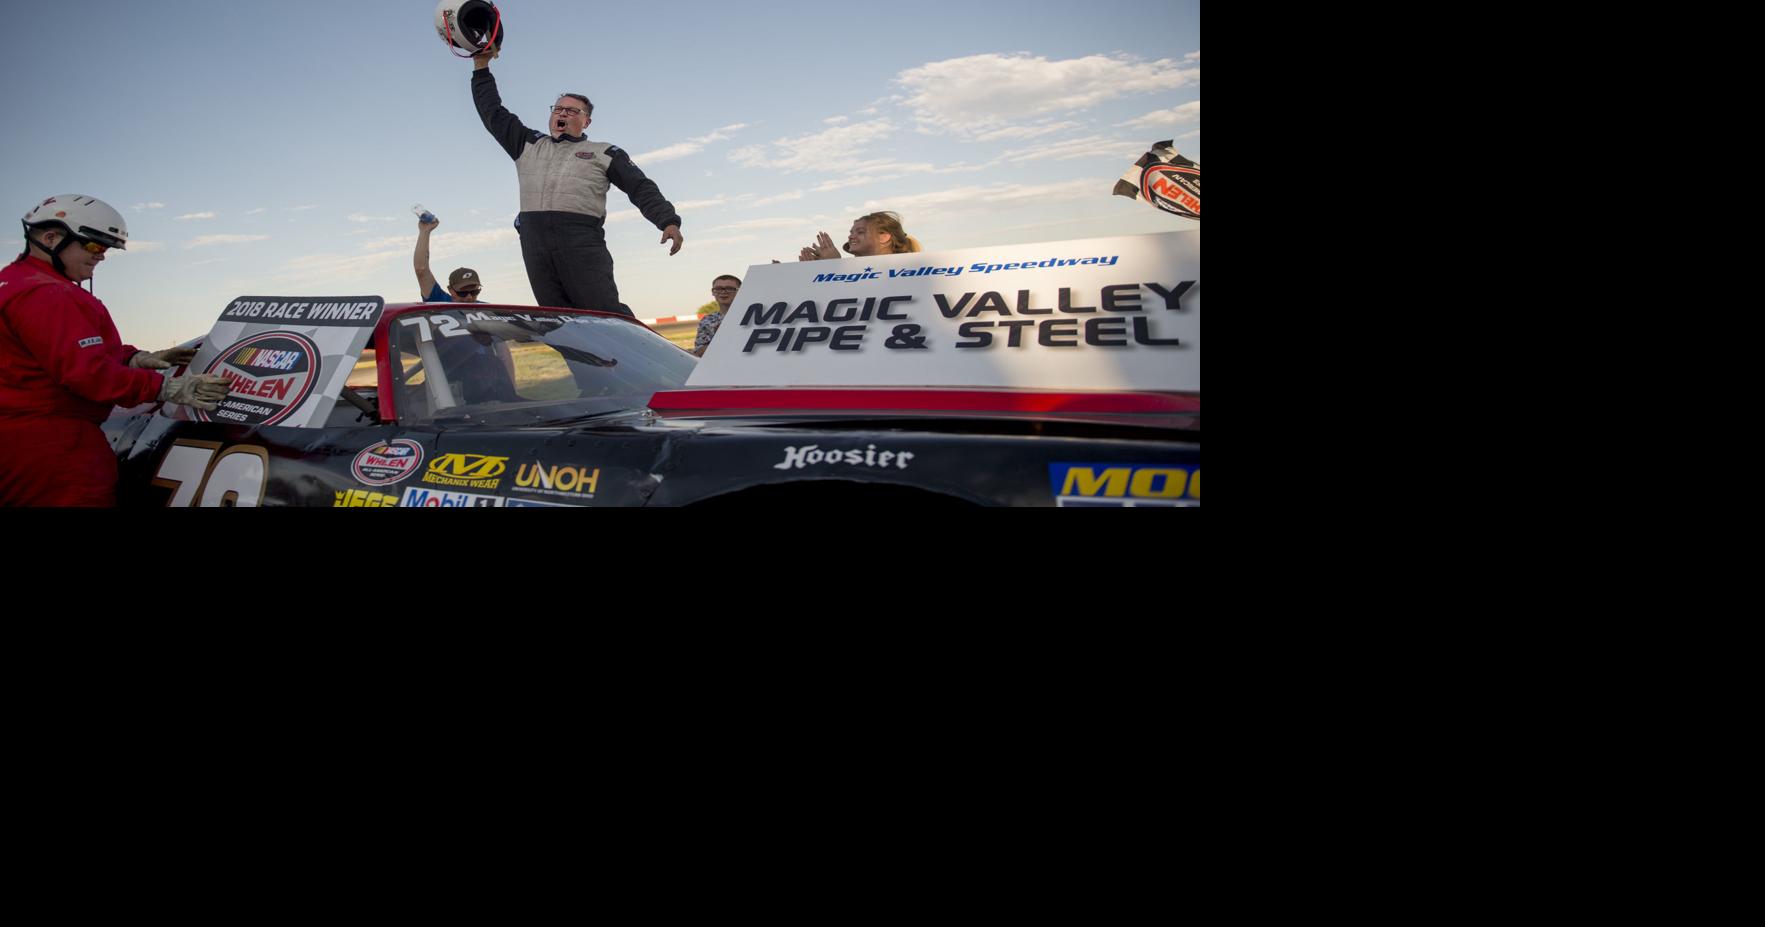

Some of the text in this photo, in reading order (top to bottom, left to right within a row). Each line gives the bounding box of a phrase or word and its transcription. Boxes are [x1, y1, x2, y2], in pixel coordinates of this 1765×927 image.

[1152, 177, 1200, 215] HELEN
[813, 255, 1120, 283] Magic Valley Speedway
[226, 301, 378, 320] 2018 RACE WINNER
[739, 280, 1197, 326] MAGIC VALLEY
[400, 314, 471, 342] 72
[742, 316, 1179, 352] PIPE & STEEL
[251, 348, 300, 370] NASCAR
[221, 367, 296, 401] WHELEN
[216, 409, 249, 422] SERIES
[217, 400, 273, 416] L-AMERICAN
[773, 443, 915, 470] Hoosier
[422, 471, 500, 489] MECHANIX WEAR
[515, 459, 600, 493] UNOH
[1060, 466, 1200, 498] MO
[406, 489, 468, 508] Mobil
